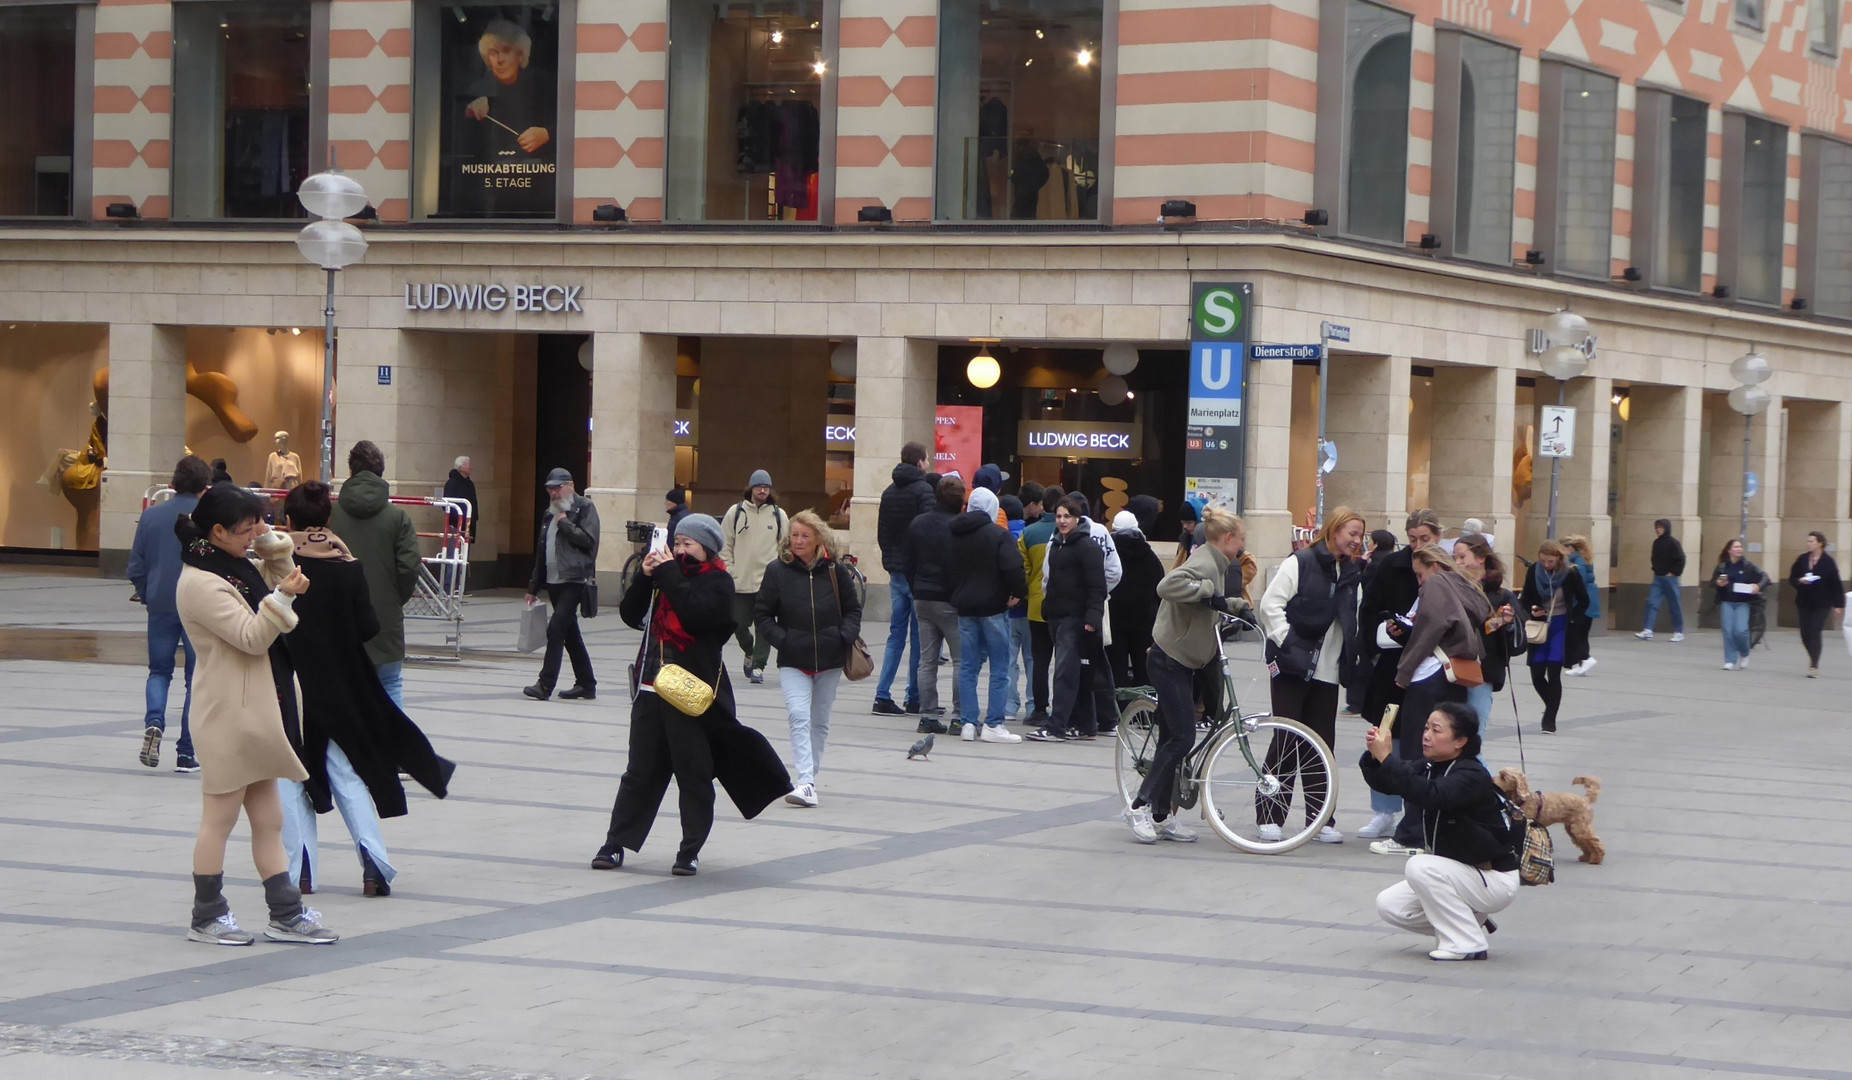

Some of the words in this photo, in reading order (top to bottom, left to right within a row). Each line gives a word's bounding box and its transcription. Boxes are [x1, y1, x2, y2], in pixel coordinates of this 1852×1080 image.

[461, 163, 556, 174] MUSIKABTEILUNG
[484, 177, 493, 188] 5.
[495, 177, 532, 188] ETAGE
[404, 283, 508, 312] LUDWIG
[513, 285, 583, 312] BECK
[1203, 290, 1236, 334] S
[1254, 345, 1314, 358] Dienerstraße
[1201, 348, 1232, 391] U
[1190, 408, 1239, 419] Marienplatz
[1029, 432, 1088, 447] LUDWIG
[1090, 433, 1130, 448] BECK
[1189, 440, 1200, 448] U3
[1205, 440, 1216, 448] U6
